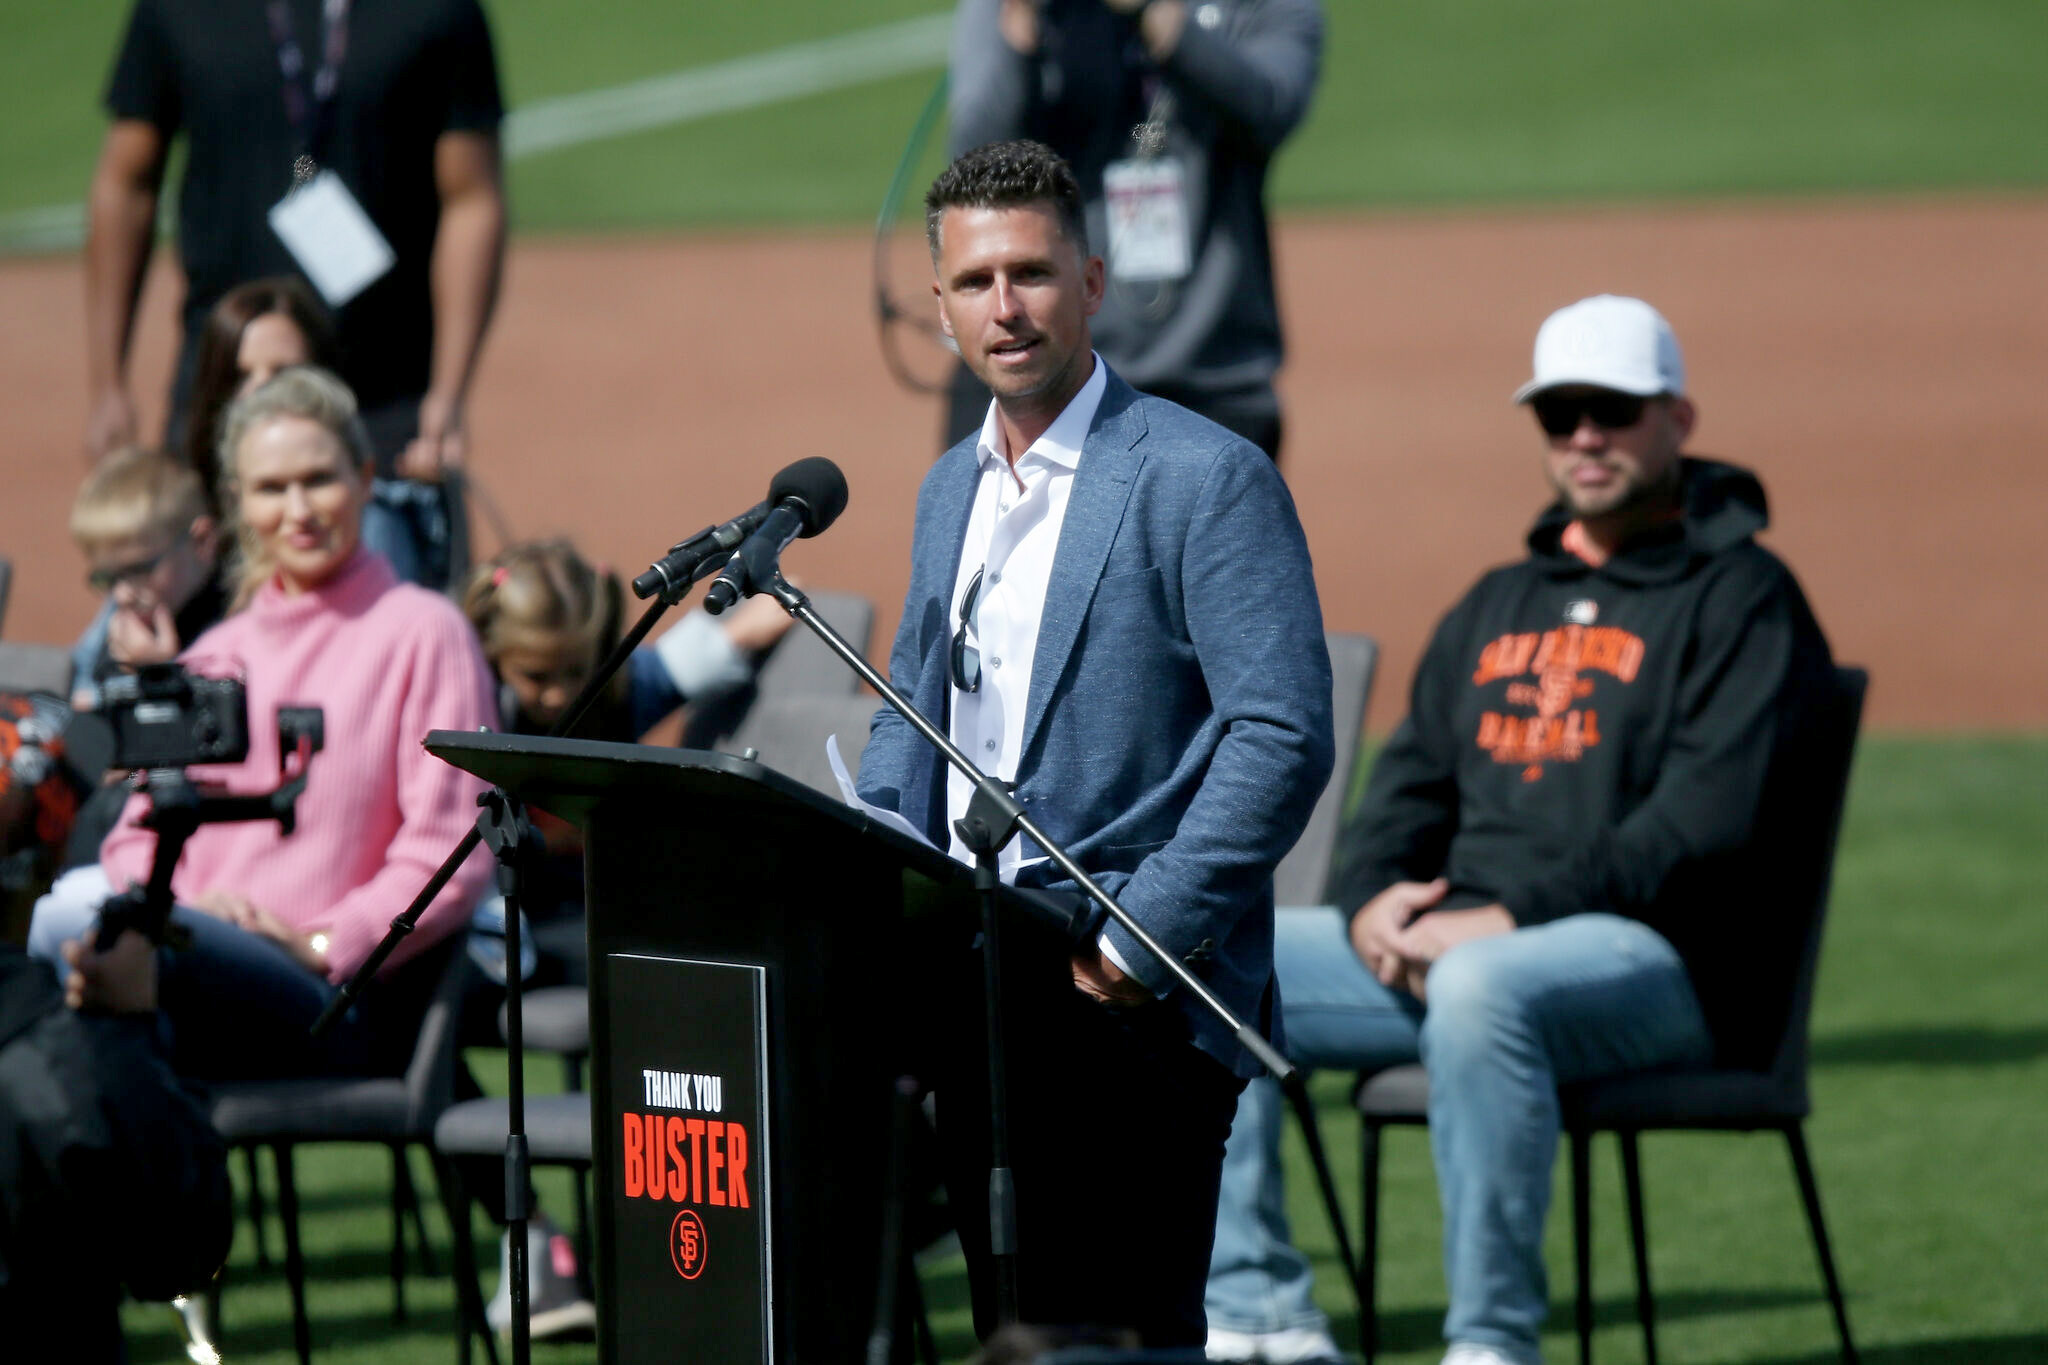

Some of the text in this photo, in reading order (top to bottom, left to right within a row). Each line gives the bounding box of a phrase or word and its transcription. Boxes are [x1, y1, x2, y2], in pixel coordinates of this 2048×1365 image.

[643, 1069, 722, 1113] THANK YOU
[623, 1112, 750, 1209] BUSTER
